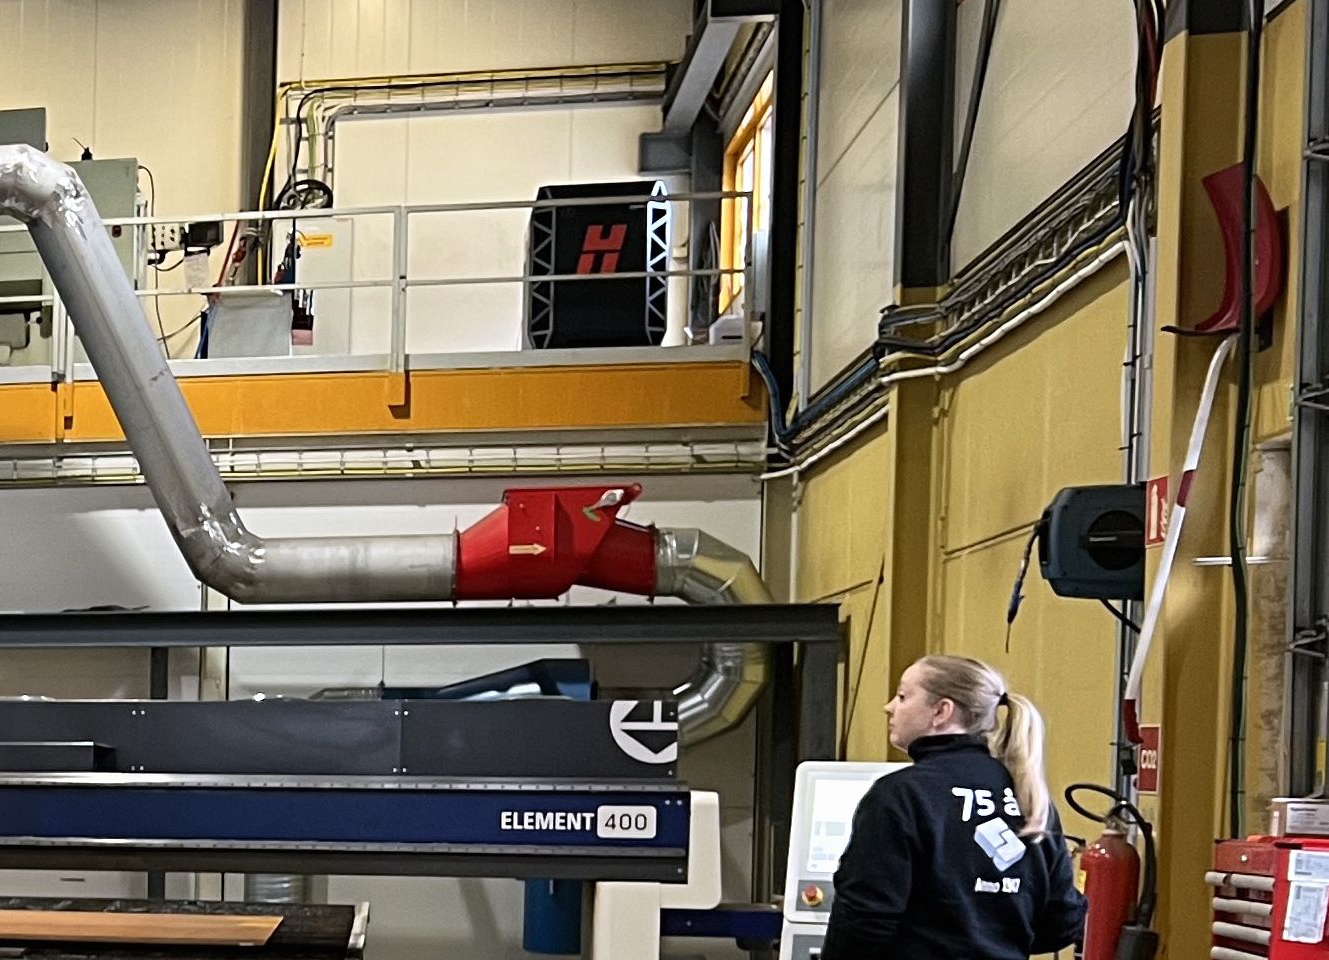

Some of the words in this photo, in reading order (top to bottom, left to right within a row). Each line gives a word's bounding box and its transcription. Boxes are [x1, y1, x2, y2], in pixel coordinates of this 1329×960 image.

[951, 787, 996, 822] 75
[501, 811, 595, 830] ELEMENT
[604, 813, 648, 831] 400
